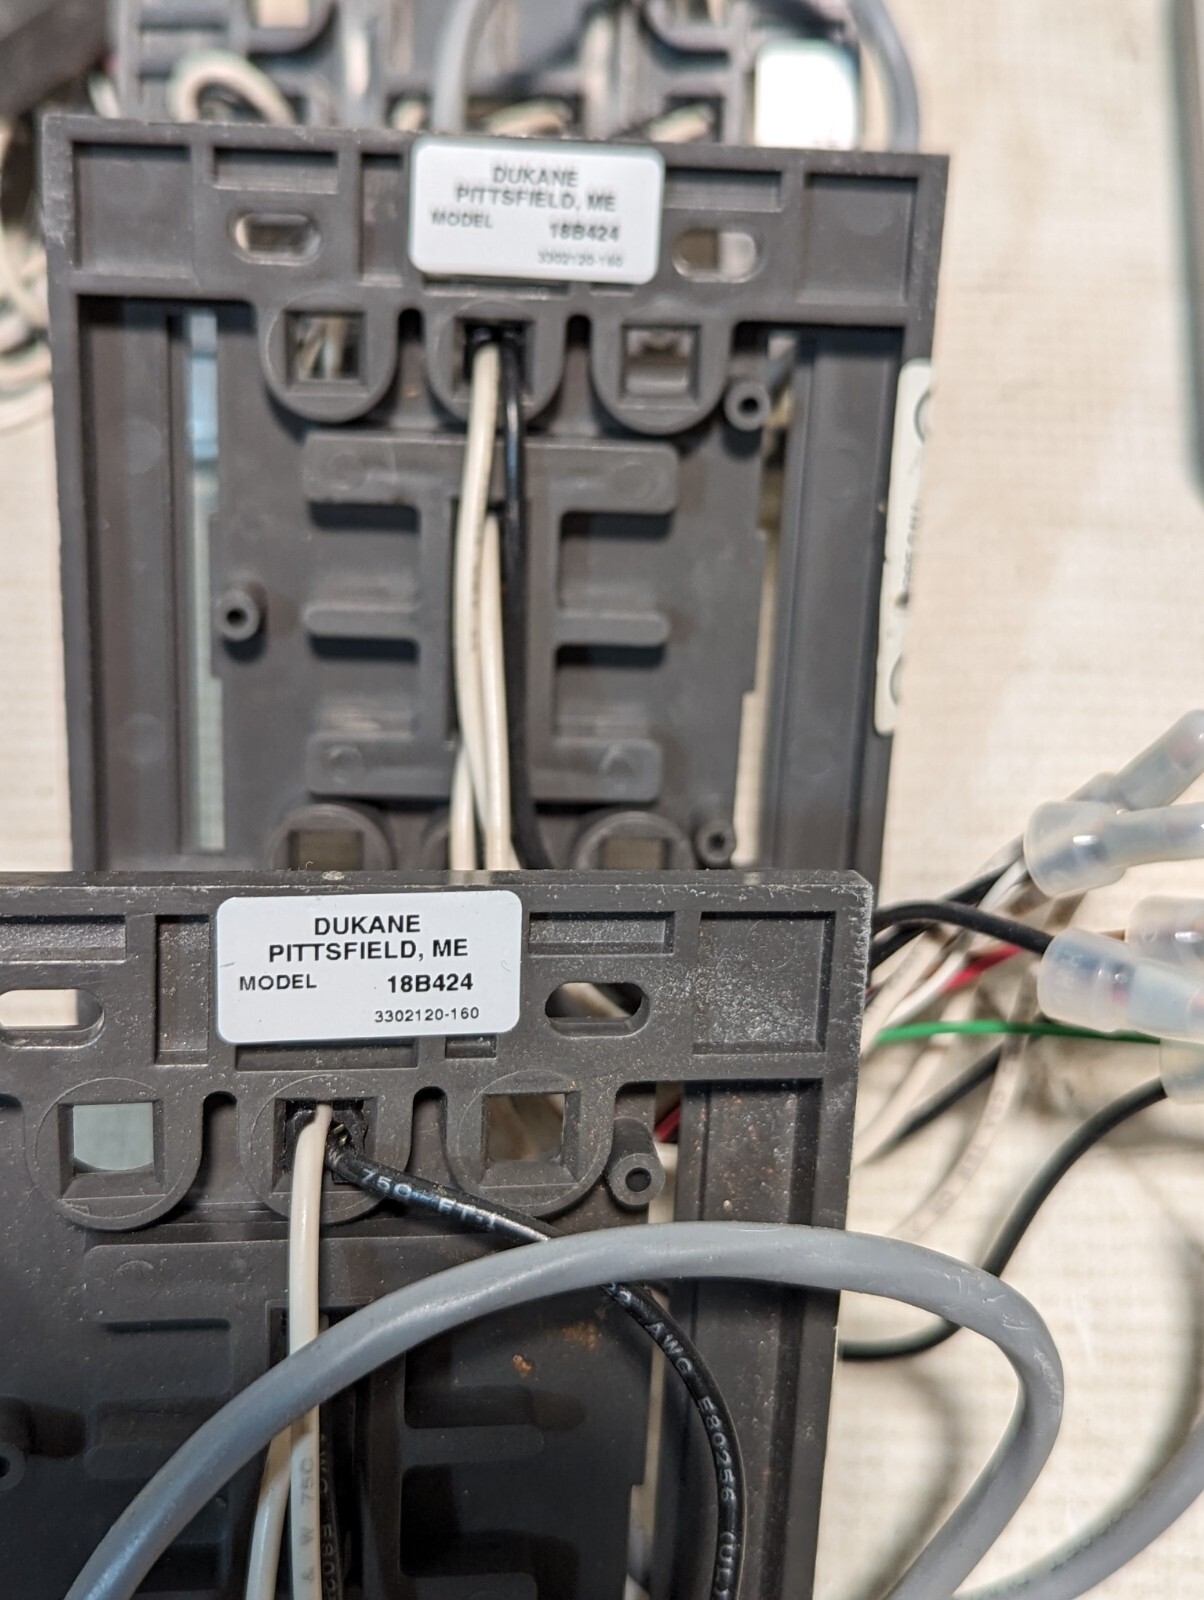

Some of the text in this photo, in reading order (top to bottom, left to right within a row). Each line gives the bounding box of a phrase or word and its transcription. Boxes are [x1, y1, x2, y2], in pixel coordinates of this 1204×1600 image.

[493, 166, 578, 187] DUKANE
[456, 186, 616, 212] PITTSFIELD, ME
[431, 210, 493, 228] MODEL
[550, 223, 620, 241] 18B424
[314, 914, 421, 936] DUKANE
[268, 938, 469, 963] PITTSFIELD, ME
[239, 973, 317, 991] MODEL
[387, 973, 474, 993] 18B424
[374, 1006, 480, 1023] 3302120-160
[646, 1321, 693, 1376] AWG
[699, 1395, 737, 1501] E80256
